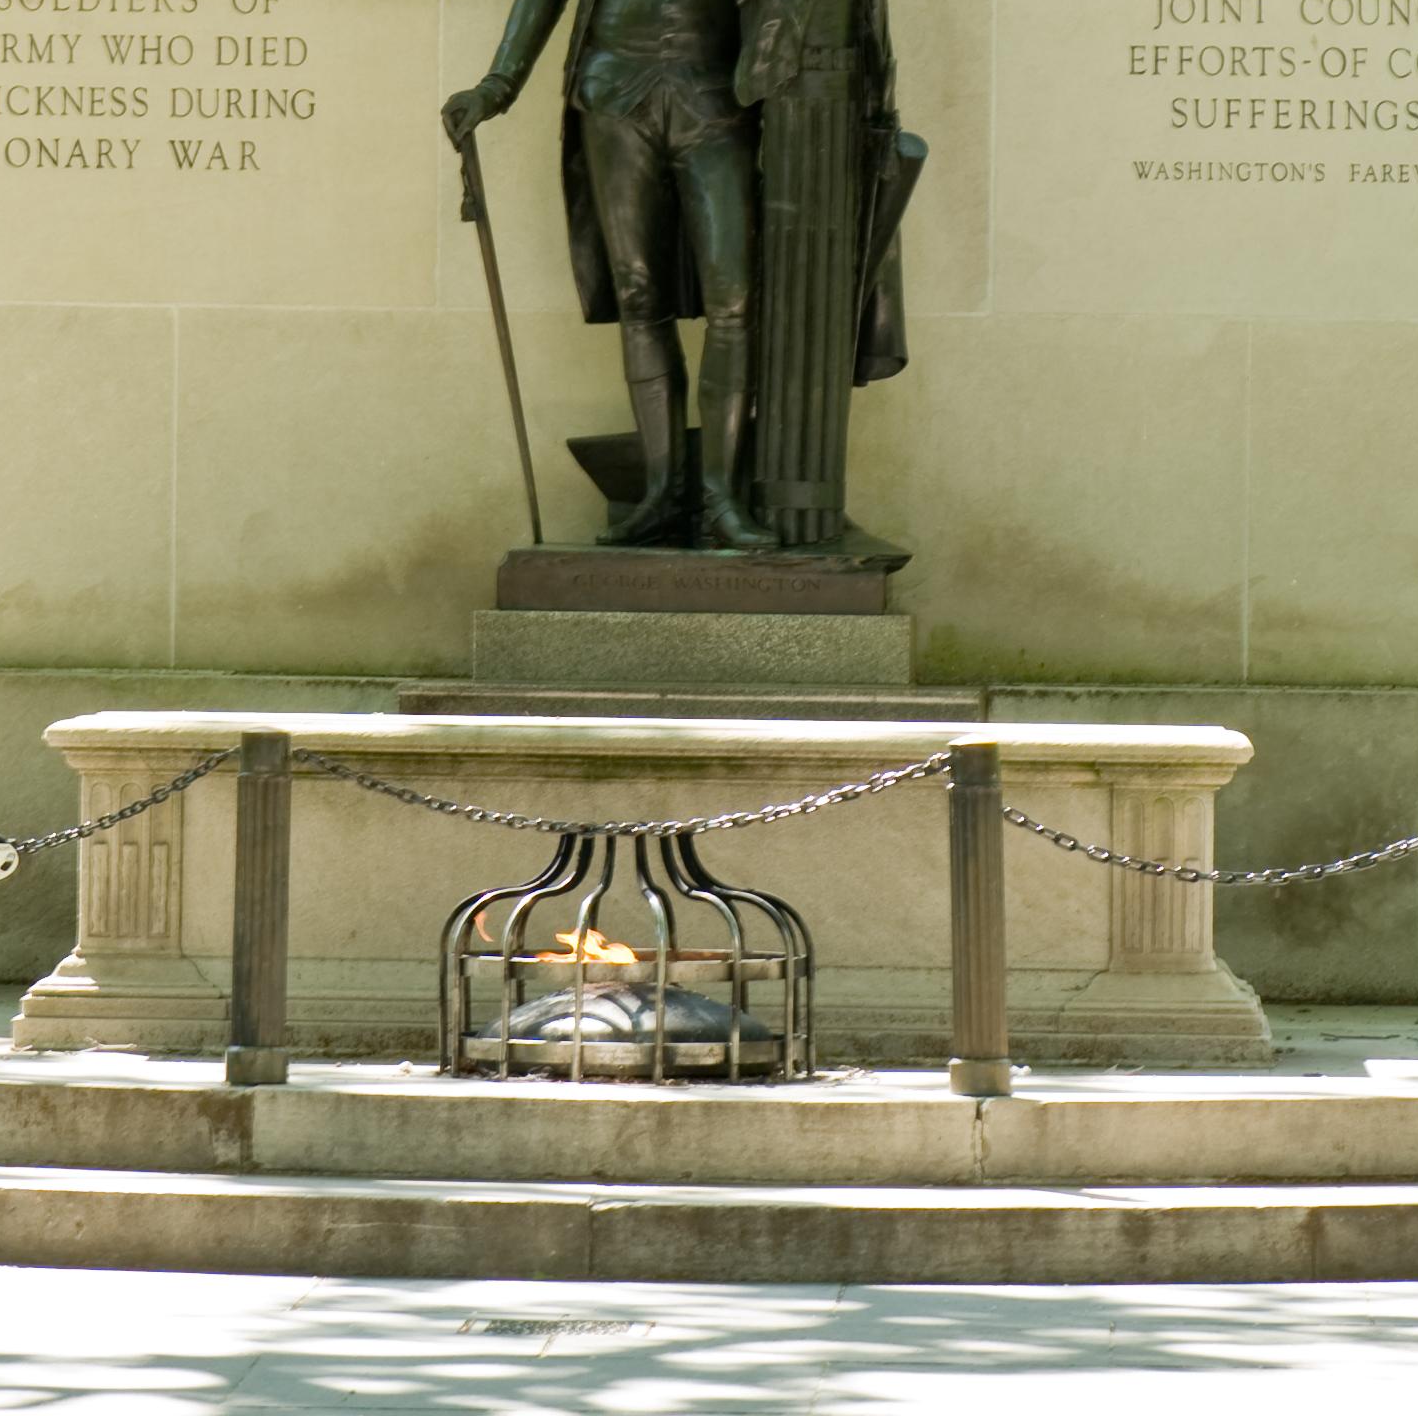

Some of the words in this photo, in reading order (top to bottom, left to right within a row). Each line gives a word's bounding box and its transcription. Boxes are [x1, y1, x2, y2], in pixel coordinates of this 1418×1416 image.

[101, 35, 193, 65] WHO
[216, 36, 307, 66] DIED
[170, 88, 315, 120] DURING
[169, 140, 259, 171] WAR
[1133, 161, 1325, 182] WASHINGTON'S
[675, 574, 821, 593] WASHINGTON
